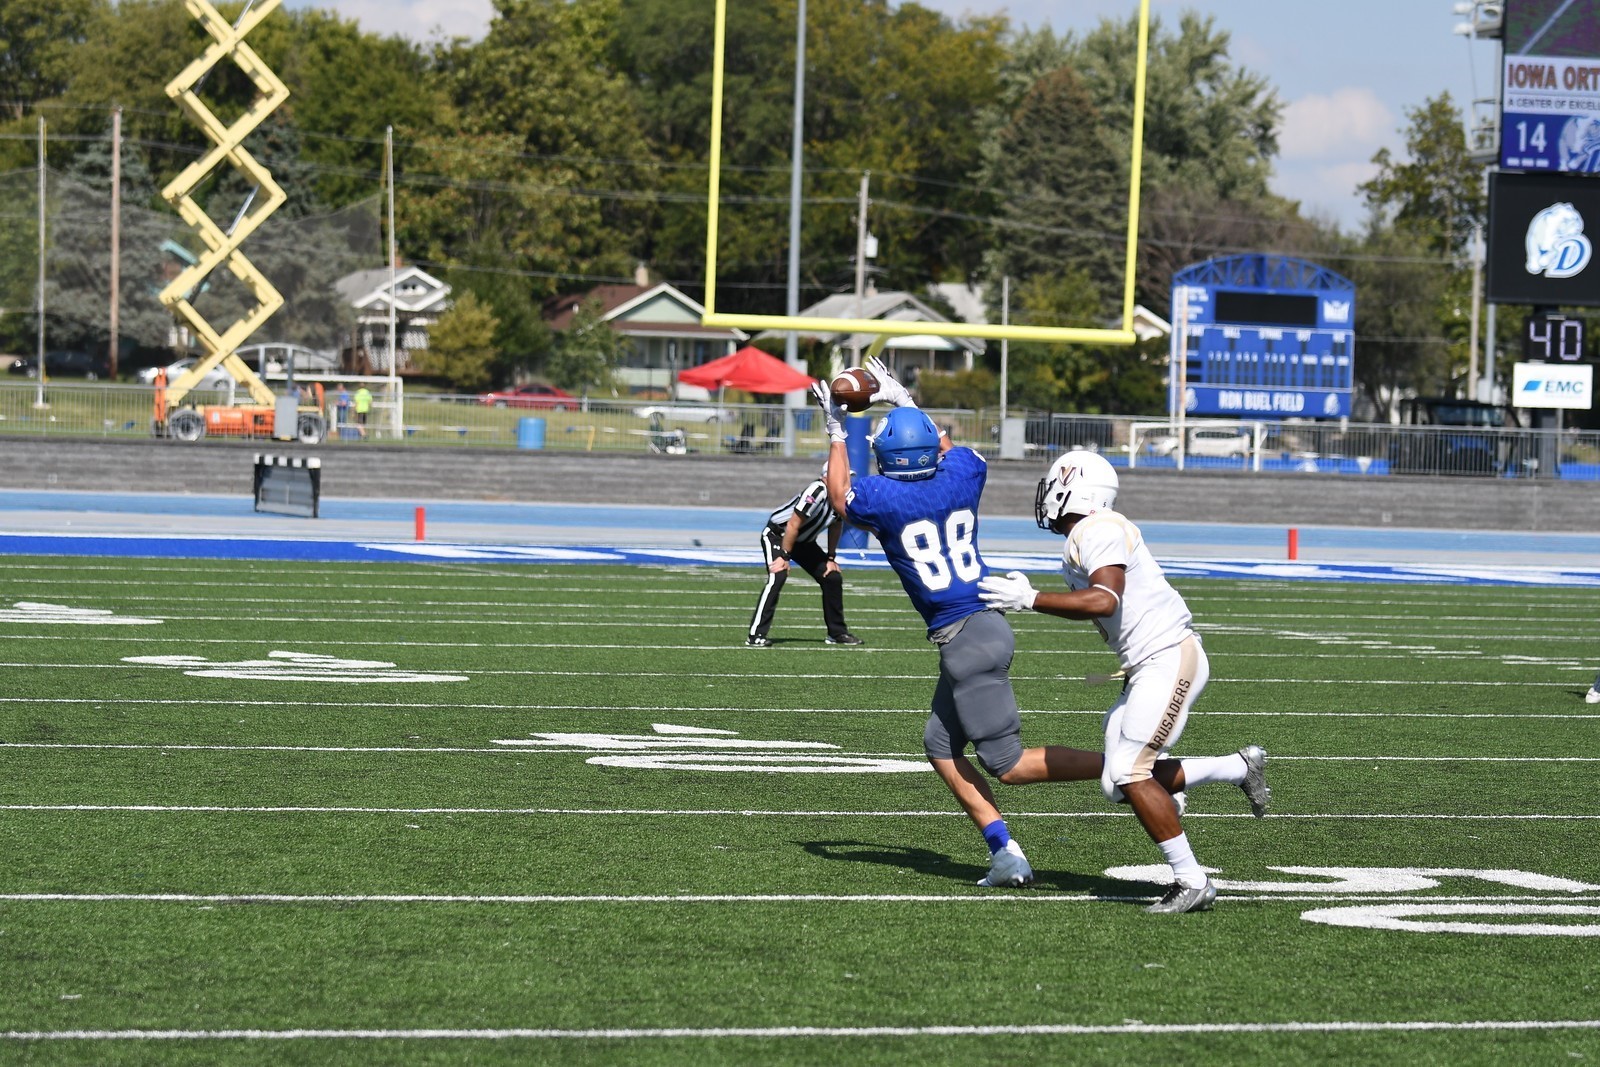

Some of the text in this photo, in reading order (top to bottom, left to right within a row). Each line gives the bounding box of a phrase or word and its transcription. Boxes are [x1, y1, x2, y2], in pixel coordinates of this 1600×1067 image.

[1508, 64, 1600, 91] IOWA ORT
[1516, 99, 1552, 108] CENTER
[1554, 100, 1567, 109] OF
[1516, 121, 1547, 152] 14
[1529, 320, 1582, 361] 40
[1545, 381, 1583, 393] EMC
[1272, 392, 1305, 412] FIELD
[901, 509, 981, 592] 88
[1147, 678, 1191, 751] CRUSADERS
